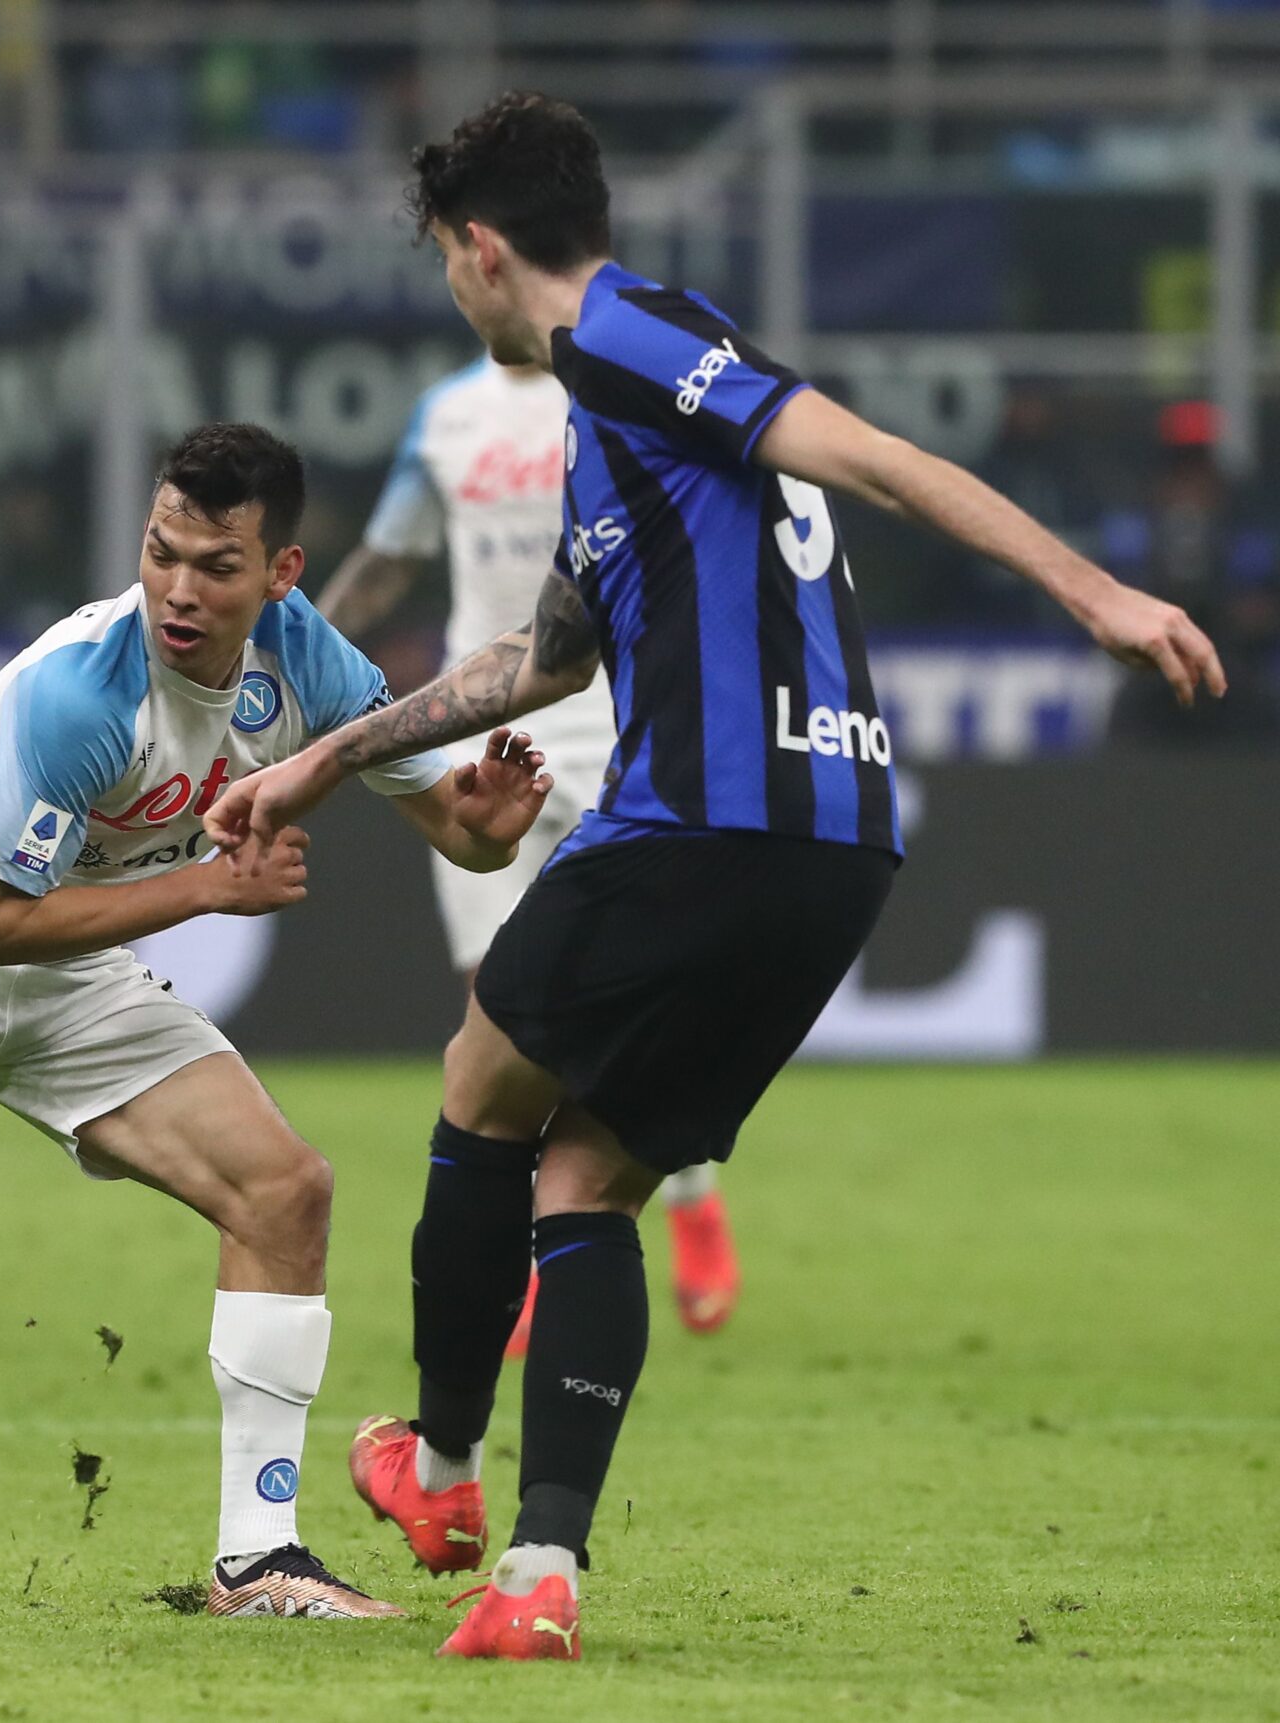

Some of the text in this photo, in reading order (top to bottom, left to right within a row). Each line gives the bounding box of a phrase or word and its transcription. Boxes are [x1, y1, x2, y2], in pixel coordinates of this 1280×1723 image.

[676, 337, 741, 416] ebay
[773, 471, 856, 594] 9
[776, 685, 891, 767] Leno
[89, 757, 263, 831] Let
[24, 838, 43, 851] SERIE
[26, 856, 44, 870] TIM
[560, 1376, 621, 1407] 1908
